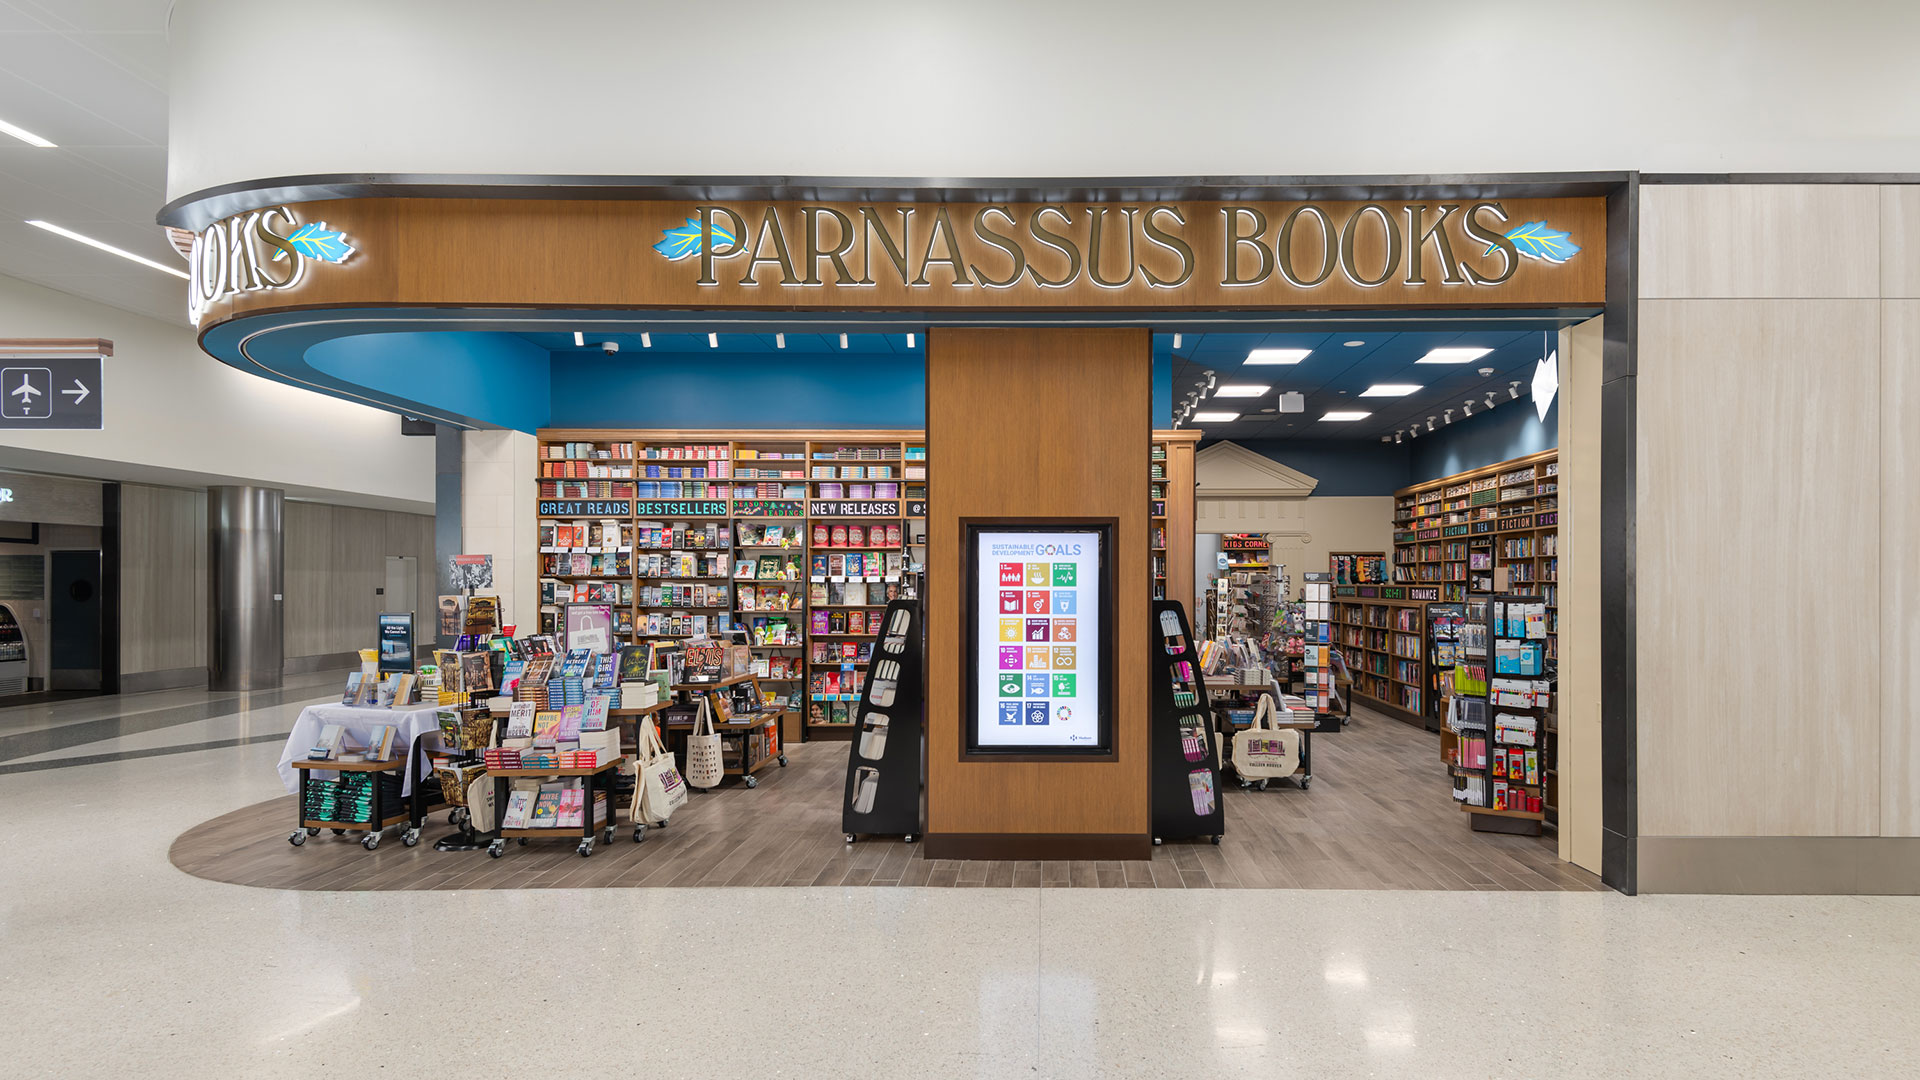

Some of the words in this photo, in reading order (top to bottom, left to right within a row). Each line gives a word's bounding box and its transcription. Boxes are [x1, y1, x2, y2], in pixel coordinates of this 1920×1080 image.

[695, 205, 1195, 289] PARNASSUS
[1219, 203, 1519, 288] BOOKS
[23, 407, 30, 415] T
[540, 502, 582, 514] GREAT
[587, 502, 629, 514] READS
[637, 503, 726, 515] BESTSELLERS
[811, 503, 837, 515] NEW
[840, 503, 896, 515] RELEASES
[1478, 523, 1488, 532] TEA
[1502, 518, 1530, 530] FICTION
[1419, 529, 1439, 540] FICTION
[1446, 525, 1468, 536] FICTION
[1036, 544, 1081, 556] GOALS
[1412, 589, 1437, 600] ROMANCE
[598, 664, 612, 672] GIRL
[511, 709, 532, 717] MERIT
